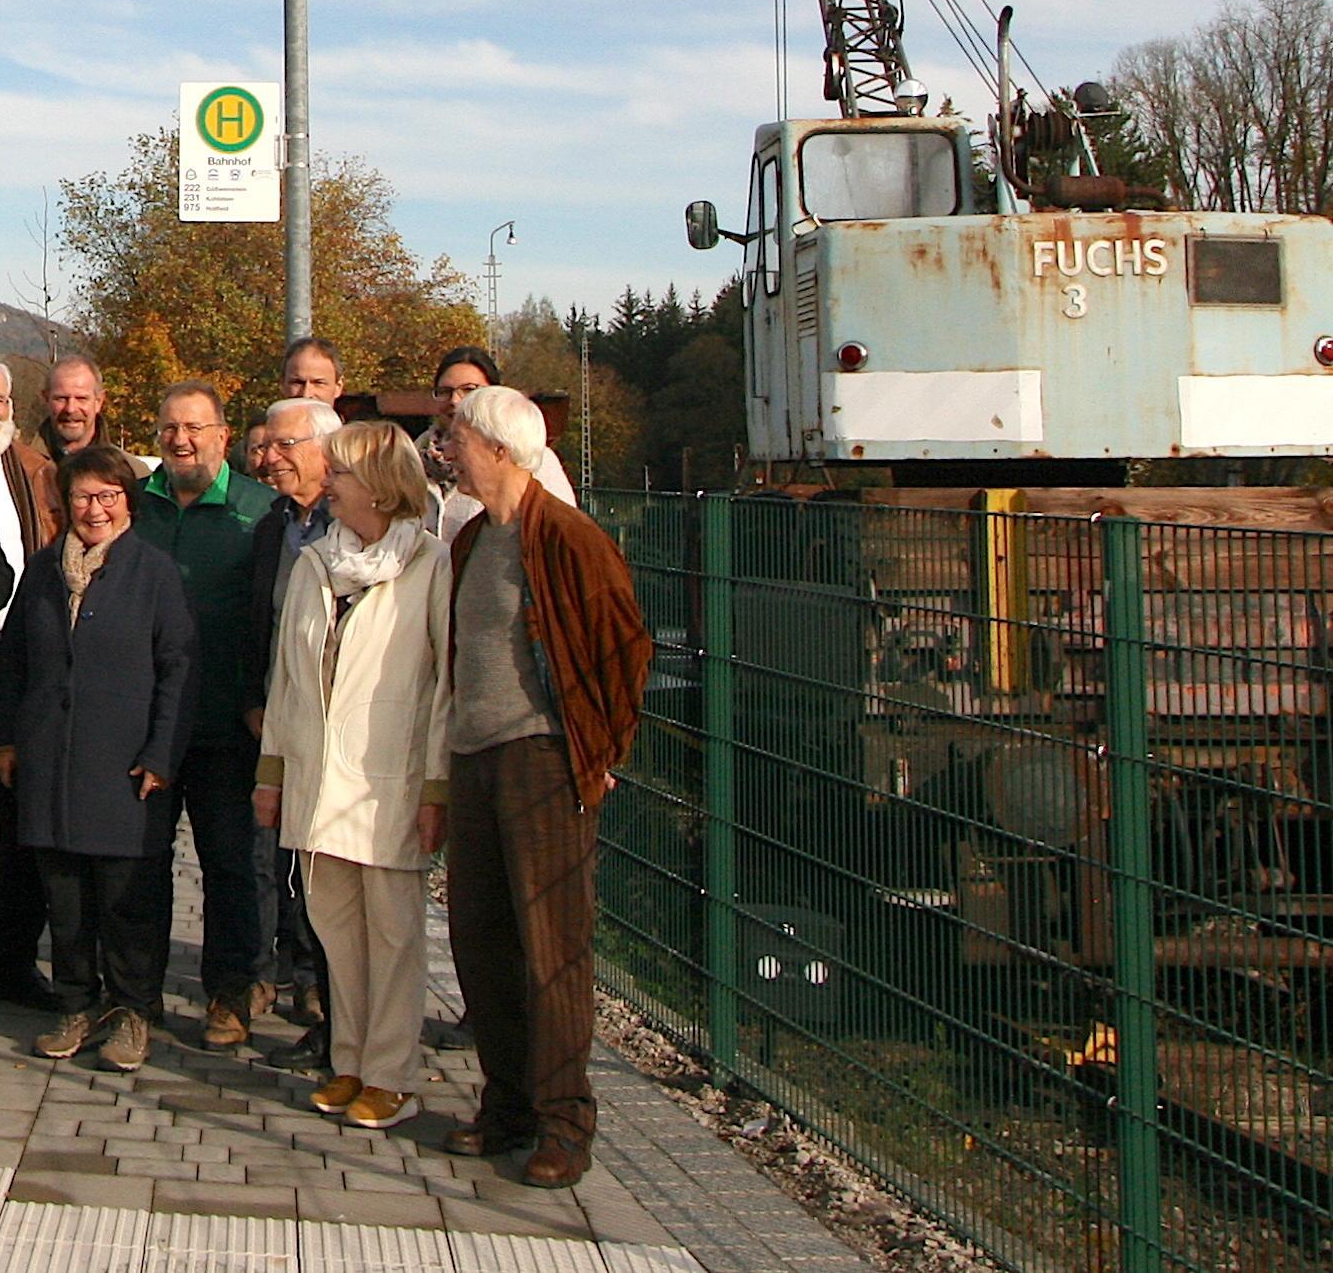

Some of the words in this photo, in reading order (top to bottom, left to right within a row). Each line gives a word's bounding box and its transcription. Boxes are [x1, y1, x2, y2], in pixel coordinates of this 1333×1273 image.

[216, 101, 243, 138] H
[208, 157, 252, 166] Bahnhof
[1033, 238, 1168, 277] FUCHS
[1061, 283, 1088, 319] 3
